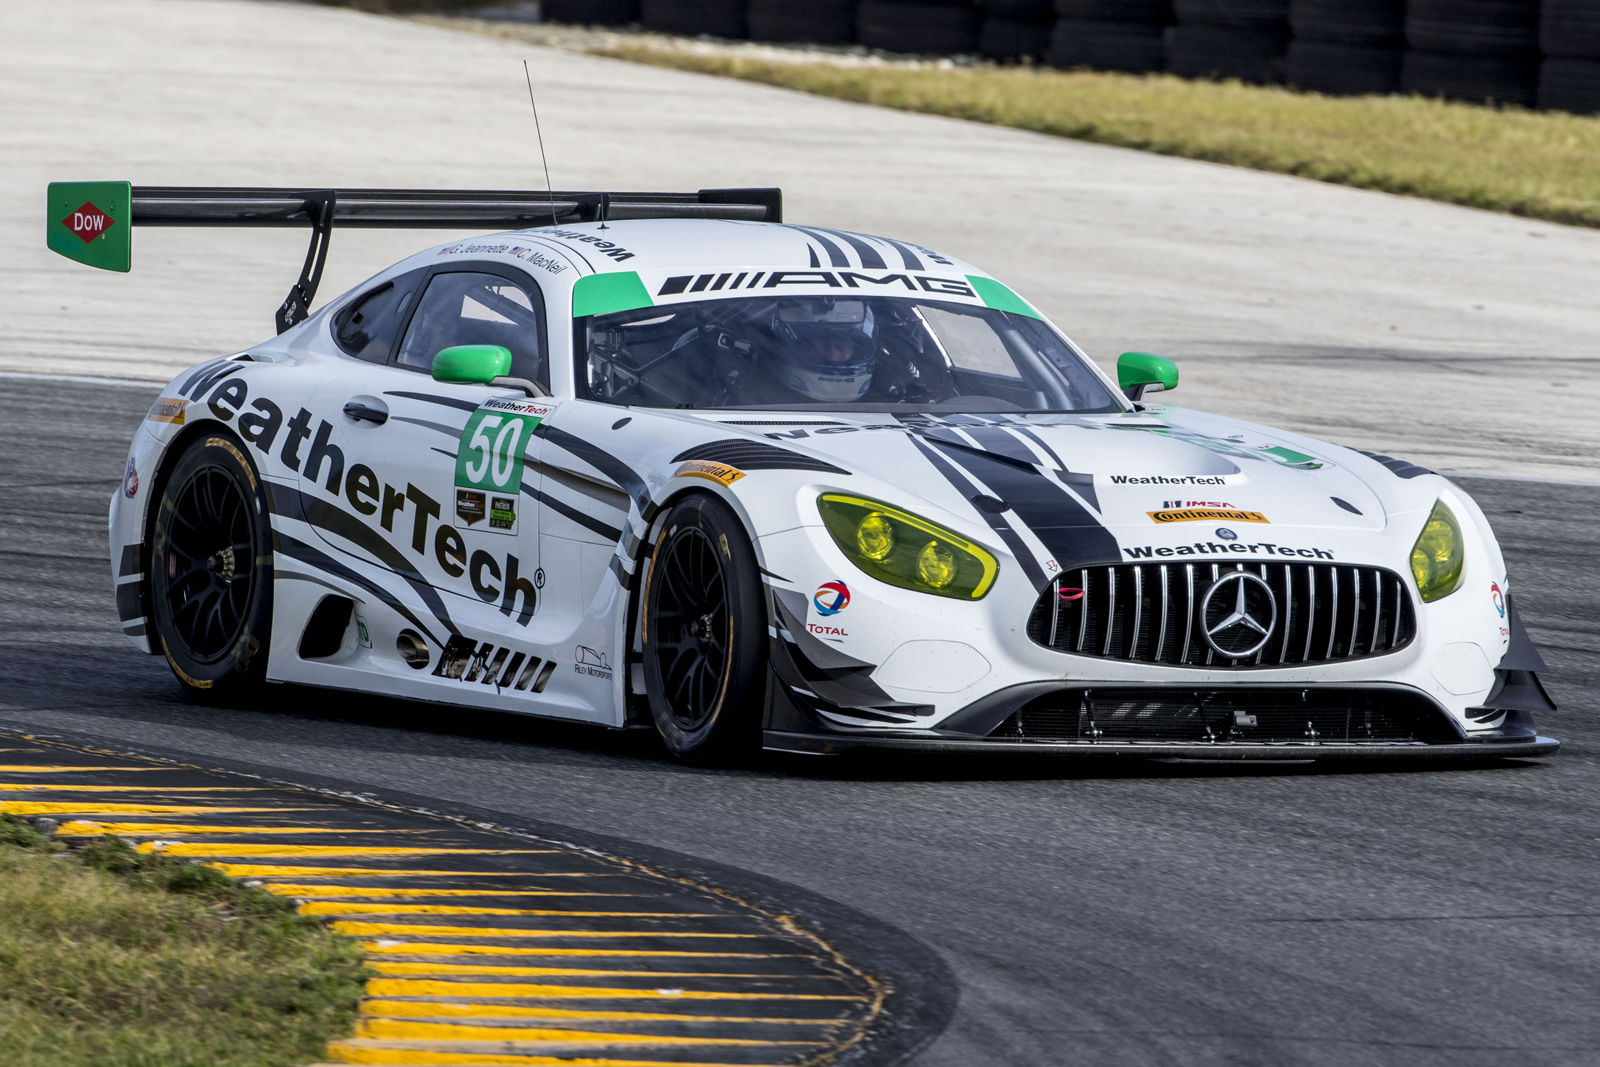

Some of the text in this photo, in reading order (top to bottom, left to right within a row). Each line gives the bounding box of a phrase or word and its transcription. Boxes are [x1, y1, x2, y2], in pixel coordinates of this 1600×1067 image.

[460, 243, 509, 254] Jeannette
[528, 251, 568, 275] MacNeil
[763, 271, 977, 298] AMG
[484, 398, 549, 415] WeatherTech
[465, 414, 524, 487] 50
[1110, 475, 1226, 486] WeatherTech
[1186, 500, 1236, 509] IMSA
[1152, 508, 1250, 523] Continental
[1122, 541, 1336, 561] WeatherTech
[807, 623, 849, 636] TOTAL
